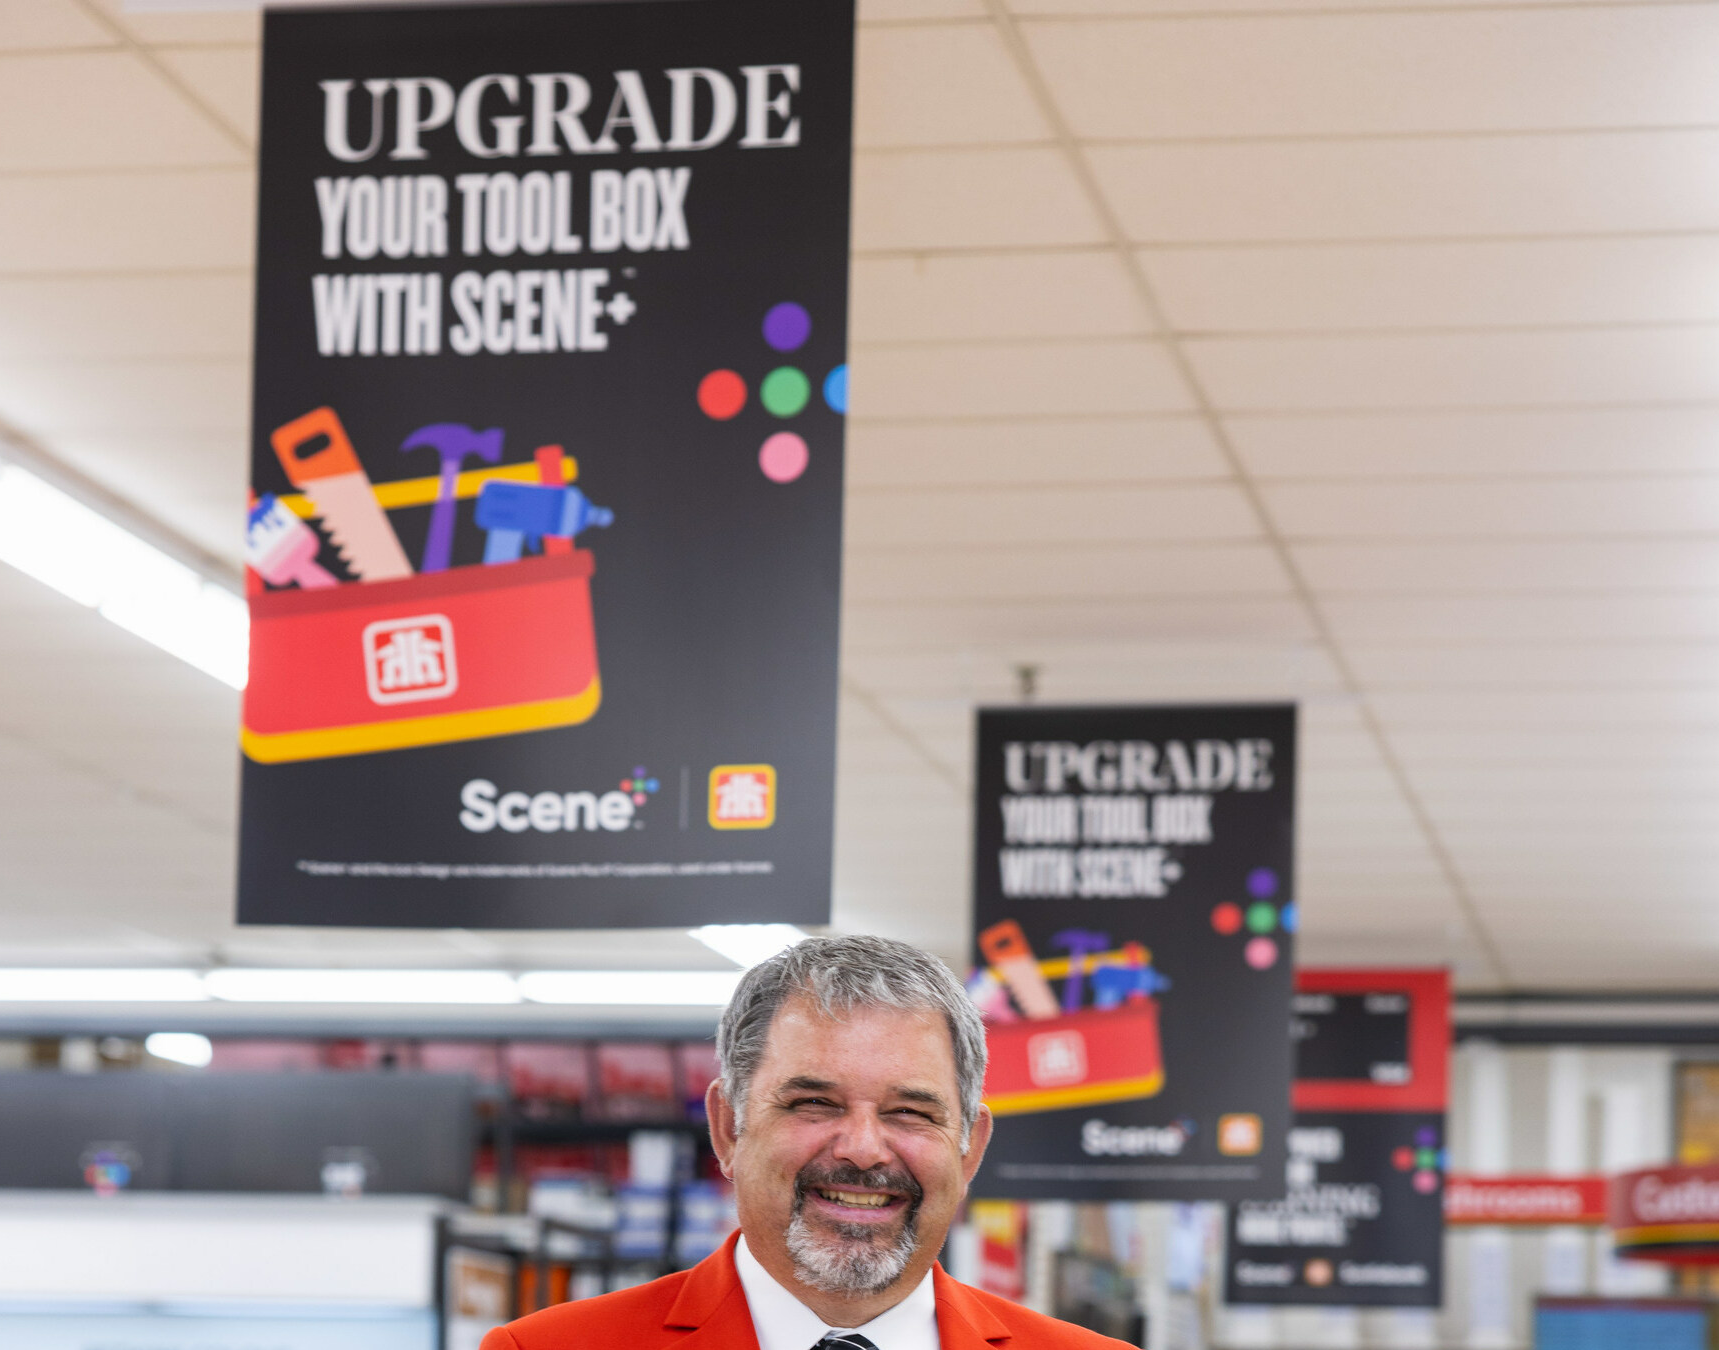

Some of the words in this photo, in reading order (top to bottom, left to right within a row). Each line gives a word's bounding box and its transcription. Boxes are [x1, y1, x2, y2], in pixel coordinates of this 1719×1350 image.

[317, 64, 802, 163] UPGRADE
[314, 175, 449, 259] YOUR
[455, 171, 582, 257] TOOL
[590, 166, 691, 253] BOX
[312, 273, 442, 357] WITH
[1003, 738, 1274, 793] UPGRADE
